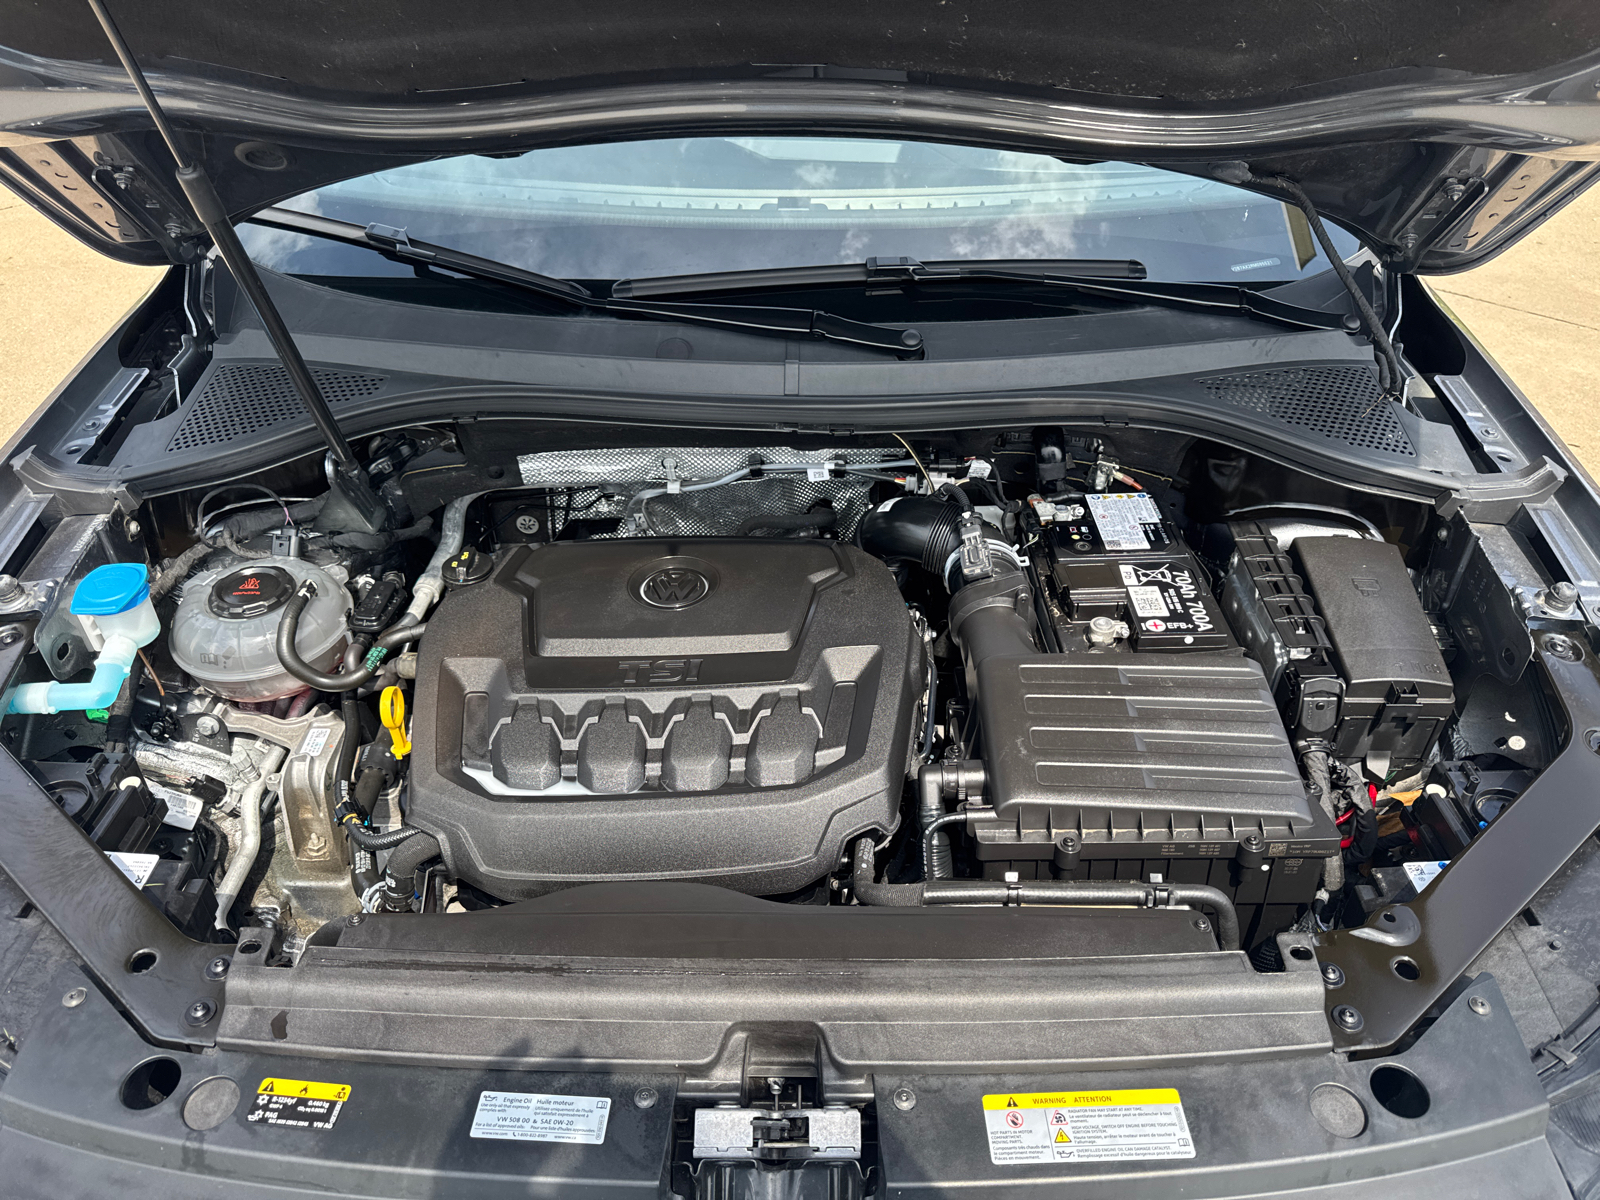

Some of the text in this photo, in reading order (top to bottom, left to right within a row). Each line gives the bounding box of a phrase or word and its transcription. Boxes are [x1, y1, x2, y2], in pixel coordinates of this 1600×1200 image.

[1123, 572, 1132, 580] Pb
[1172, 570, 1214, 632] 70Ah 700A
[618, 658, 703, 684] TSI
[135, 875, 145, 884] R
[503, 1097, 523, 1105] Engine
